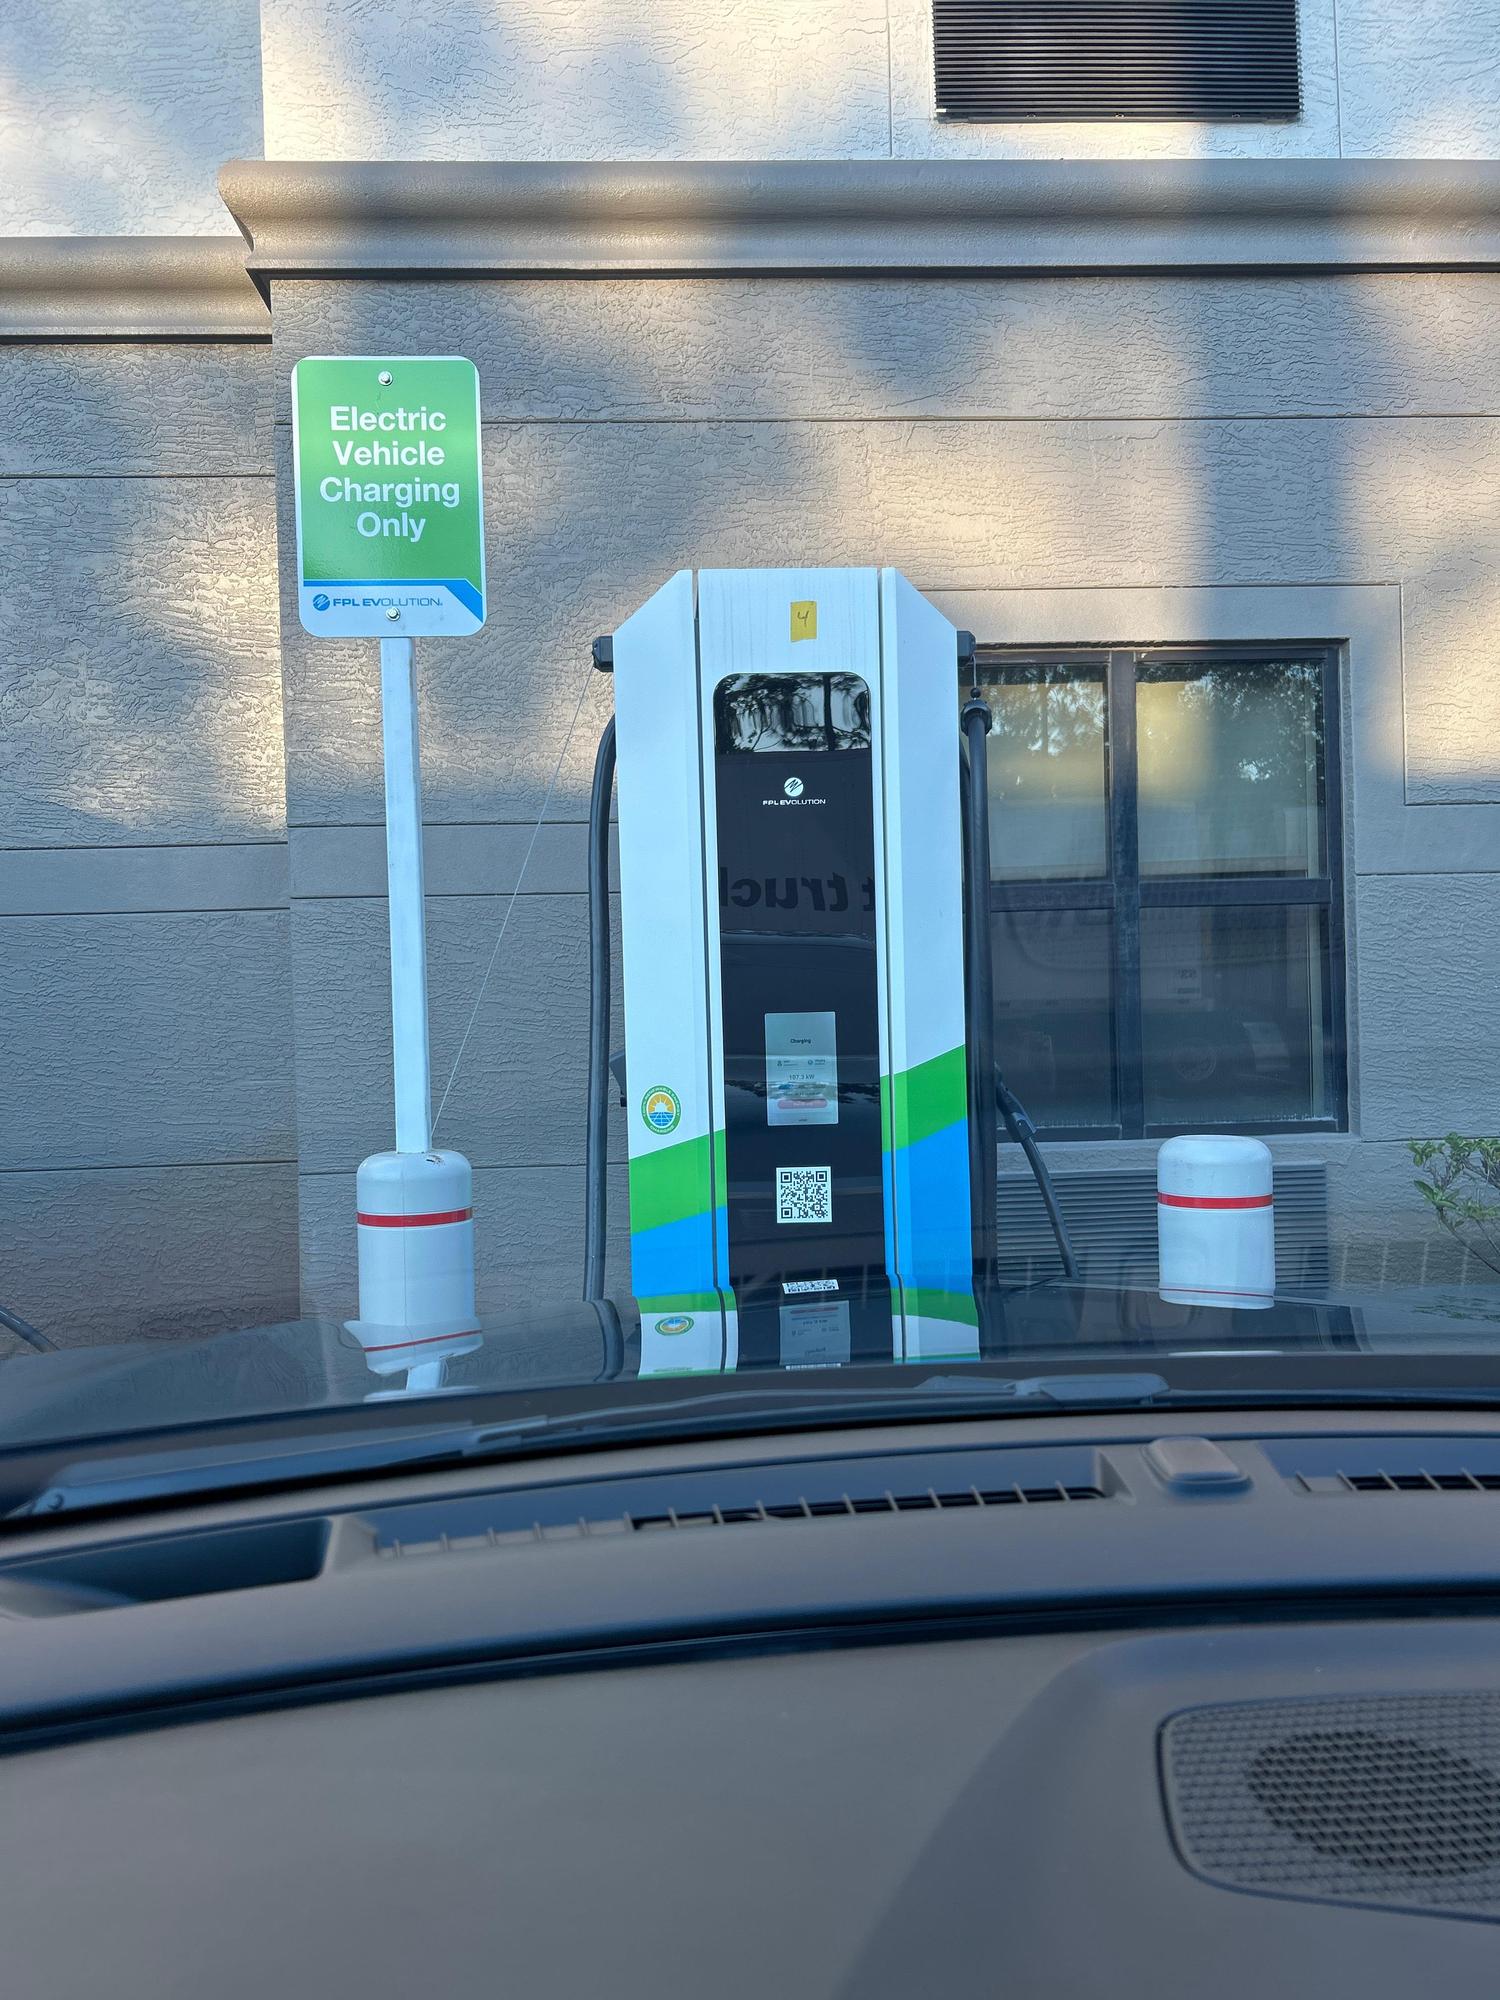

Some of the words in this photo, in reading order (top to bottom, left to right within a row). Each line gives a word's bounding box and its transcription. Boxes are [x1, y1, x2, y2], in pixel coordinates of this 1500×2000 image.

[330, 405, 447, 432] Electric
[332, 440, 446, 466] Vehicle
[319, 476, 460, 508] Charging
[356, 511, 427, 543] Only
[333, 597, 361, 607] FPL
[362, 597, 441, 607] EVOLUTION
[797, 610, 810, 628] 4
[779, 798, 826, 806] EVOLUTION
